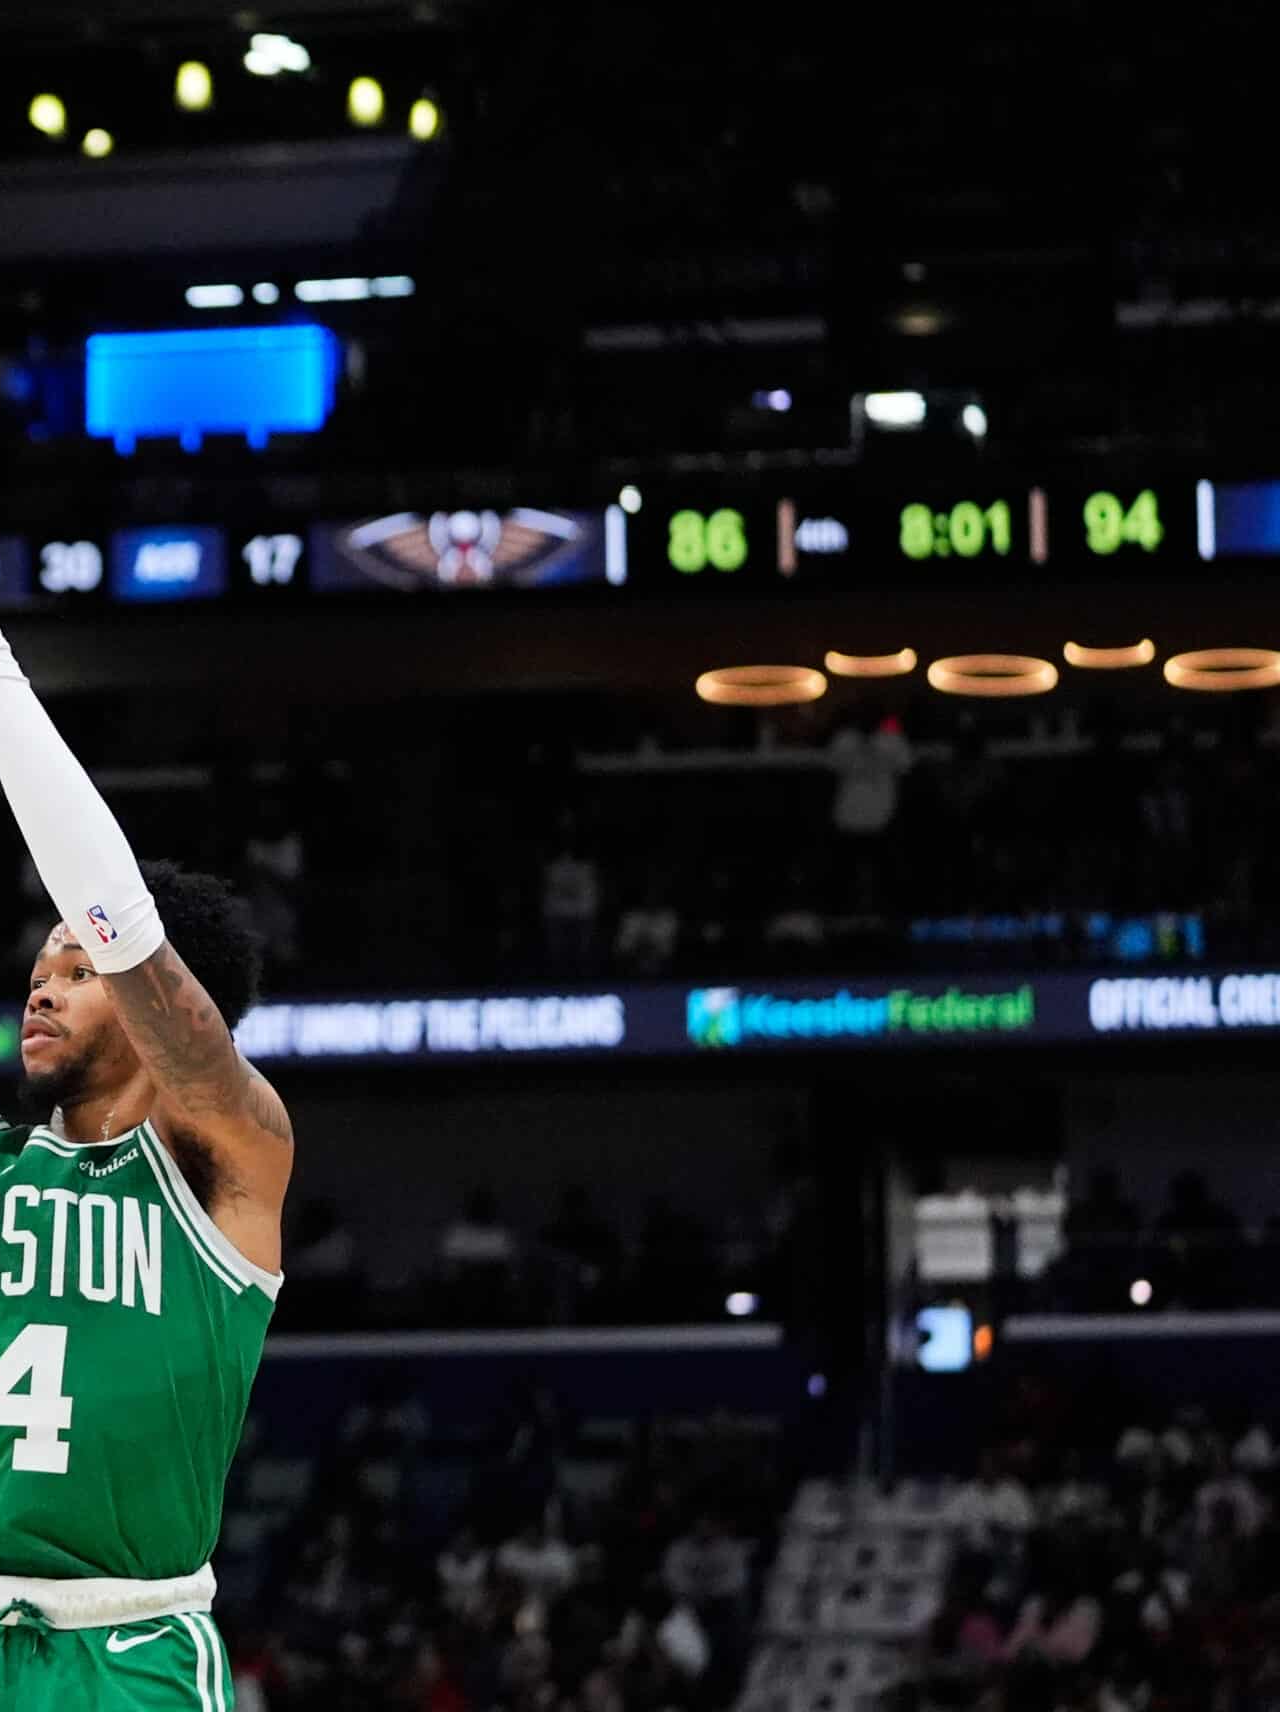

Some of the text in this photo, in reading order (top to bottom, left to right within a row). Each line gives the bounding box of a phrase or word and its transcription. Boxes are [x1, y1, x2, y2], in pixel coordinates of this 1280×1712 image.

[669, 509, 744, 572] 86
[899, 502, 1010, 557] 8:01
[1083, 490, 1163, 552] 94
[243, 535, 301, 582] 17
[79, 1148, 139, 1178] Amica
